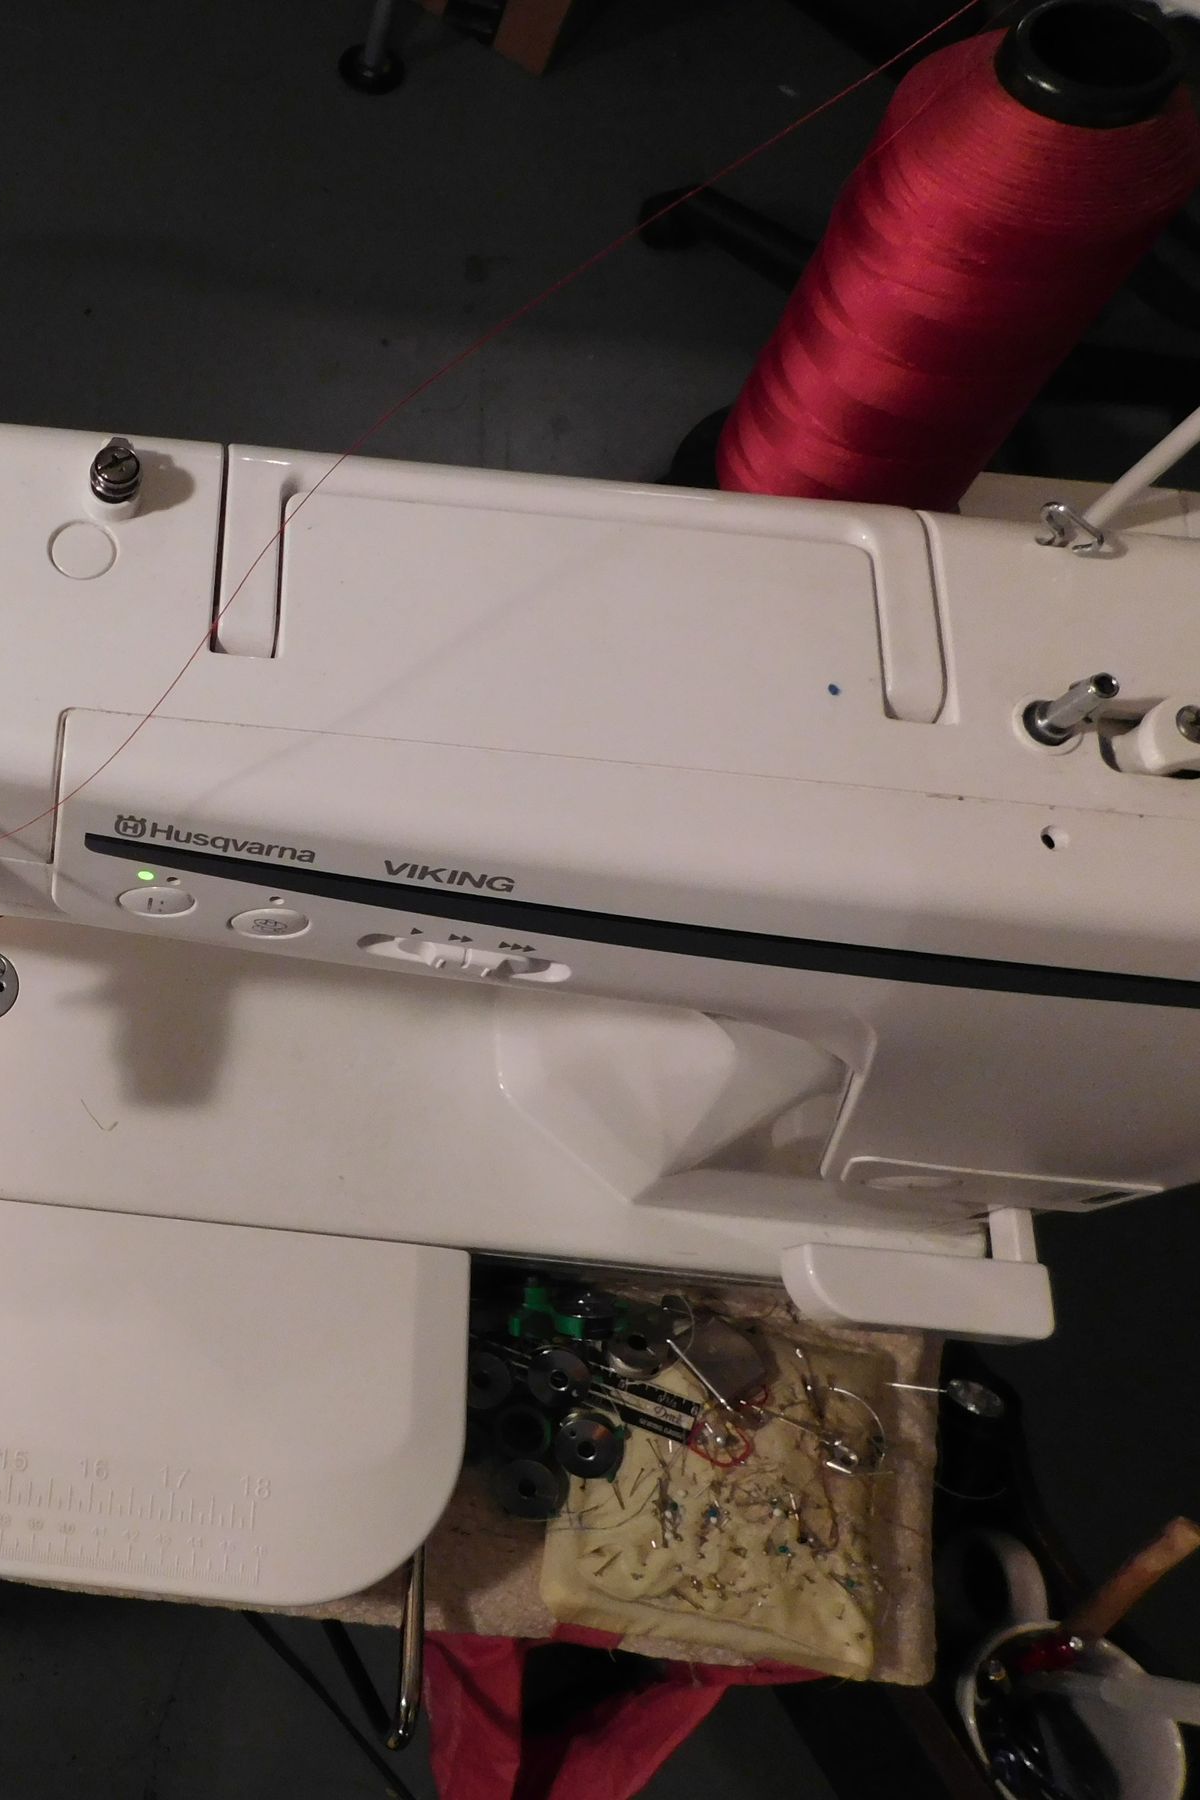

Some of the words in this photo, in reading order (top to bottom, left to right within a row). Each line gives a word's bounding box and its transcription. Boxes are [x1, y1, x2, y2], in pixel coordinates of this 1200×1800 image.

[150, 822, 316, 864] Husqvarna
[384, 859, 516, 893] VIKING
[79, 1457, 109, 1481] 16
[160, 1463, 191, 1489] 17
[240, 1474, 272, 1499] 18
